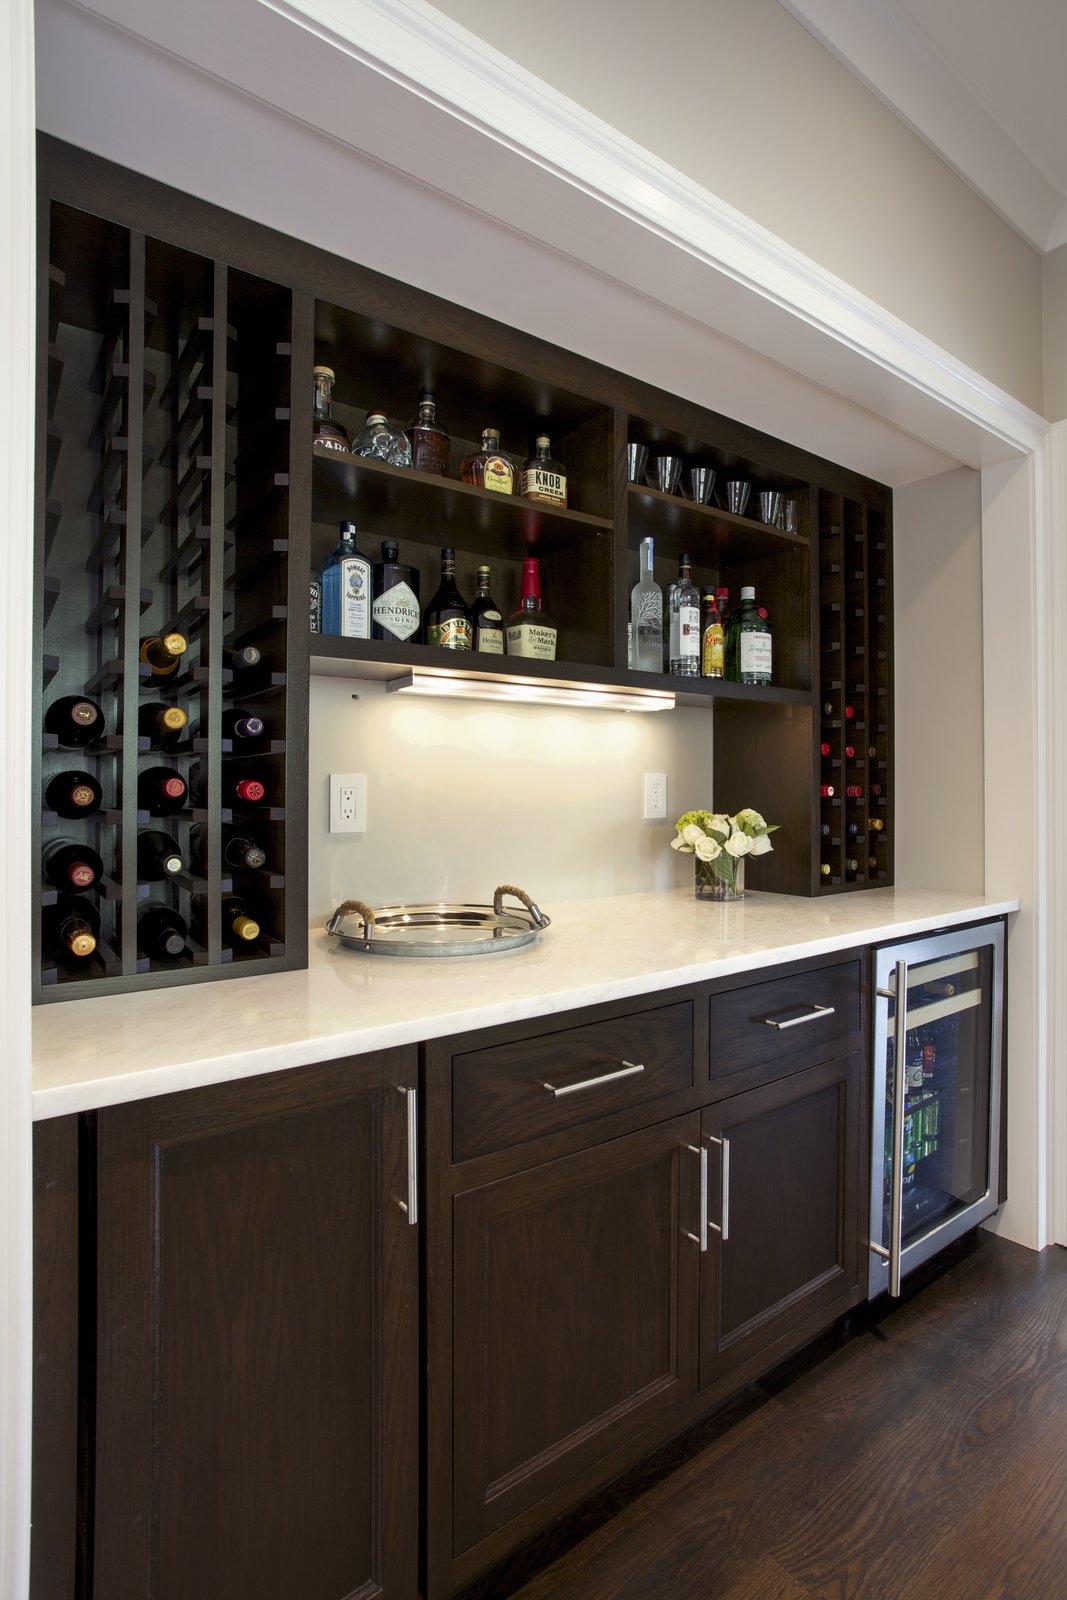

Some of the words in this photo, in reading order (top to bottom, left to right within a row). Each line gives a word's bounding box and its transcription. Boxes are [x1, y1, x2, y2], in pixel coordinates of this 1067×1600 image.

[535, 470, 561, 490] KNOB
[538, 485, 564, 497] CREEK
[346, 564, 366, 576] BOMBAY
[345, 591, 367, 602] SAPPHIRE
[394, 616, 410, 624] GIN
[528, 628, 556, 639] Maker's
[537, 636, 556, 647] Mark
